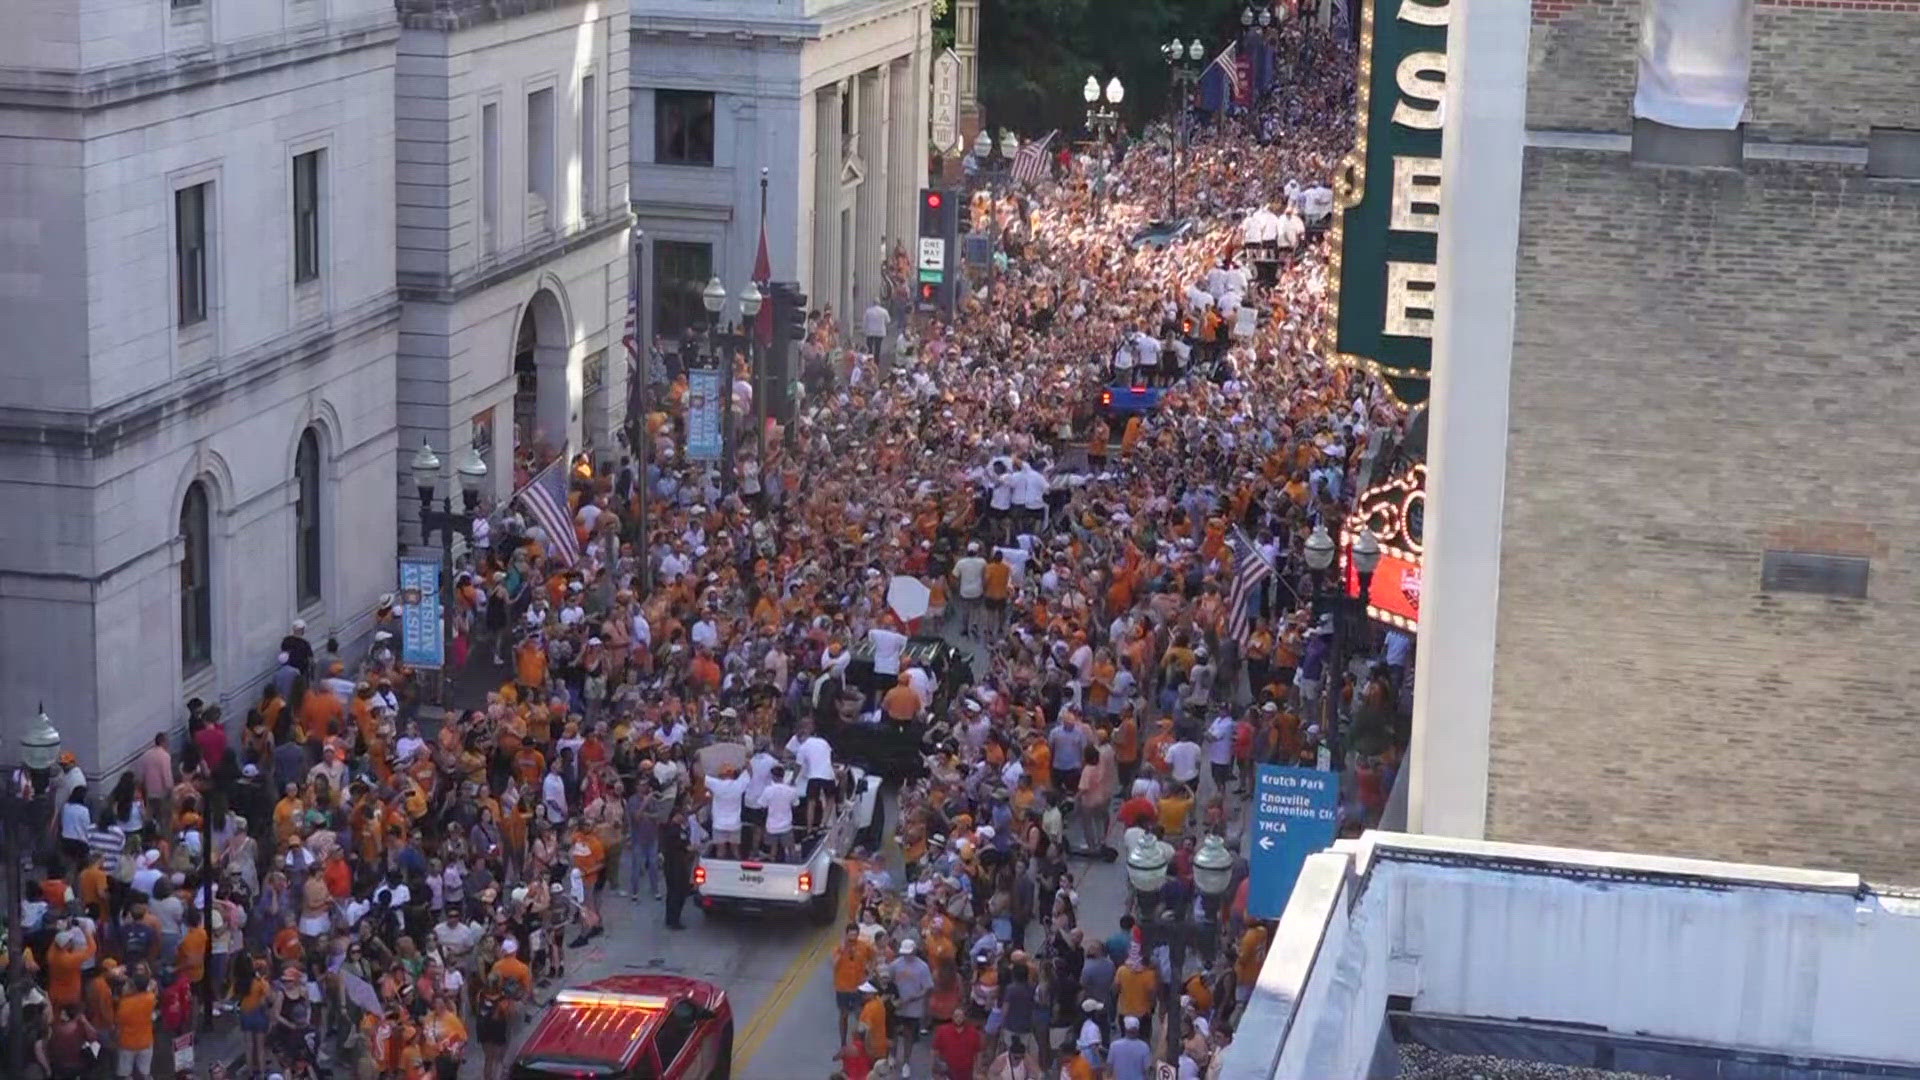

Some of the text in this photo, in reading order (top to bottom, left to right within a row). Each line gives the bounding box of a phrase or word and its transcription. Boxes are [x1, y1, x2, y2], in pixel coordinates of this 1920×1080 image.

[940, 61, 952, 122] VIDA
[924, 241, 939, 249] ONE
[421, 563, 436, 653] MUSEUM
[1262, 775, 1325, 790] Krutch Park
[1261, 793, 1310, 807] Knoxville
[1260, 803, 1336, 821] Convention Ctr.
[1259, 821, 1287, 833] YMCA
[739, 874, 764, 884] Jeep
